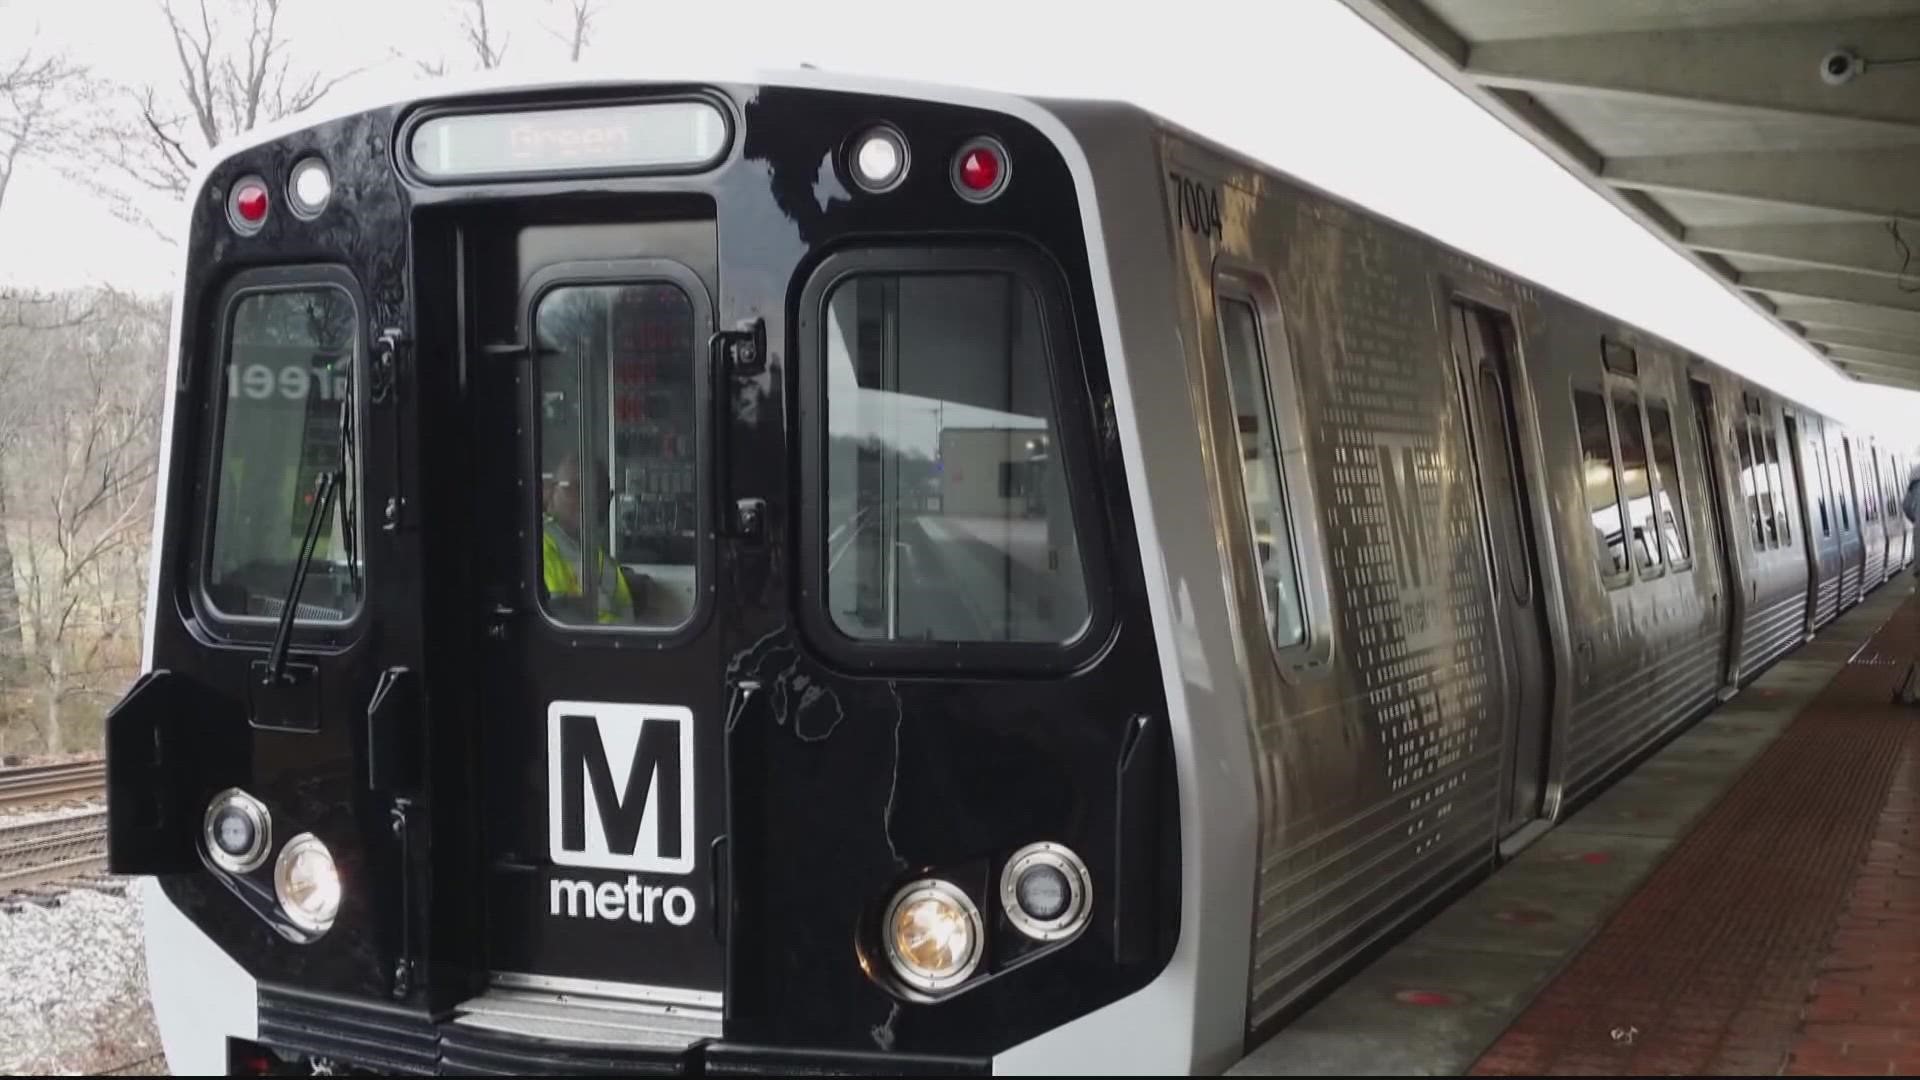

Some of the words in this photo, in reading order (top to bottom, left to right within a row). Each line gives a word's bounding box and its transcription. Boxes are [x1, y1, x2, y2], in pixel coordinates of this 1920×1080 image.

[511, 124, 629, 158] Green
[1169, 172, 1223, 241] 7004
[1377, 444, 1434, 590] M
[559, 714, 682, 860] M
[550, 875, 695, 926] metro
